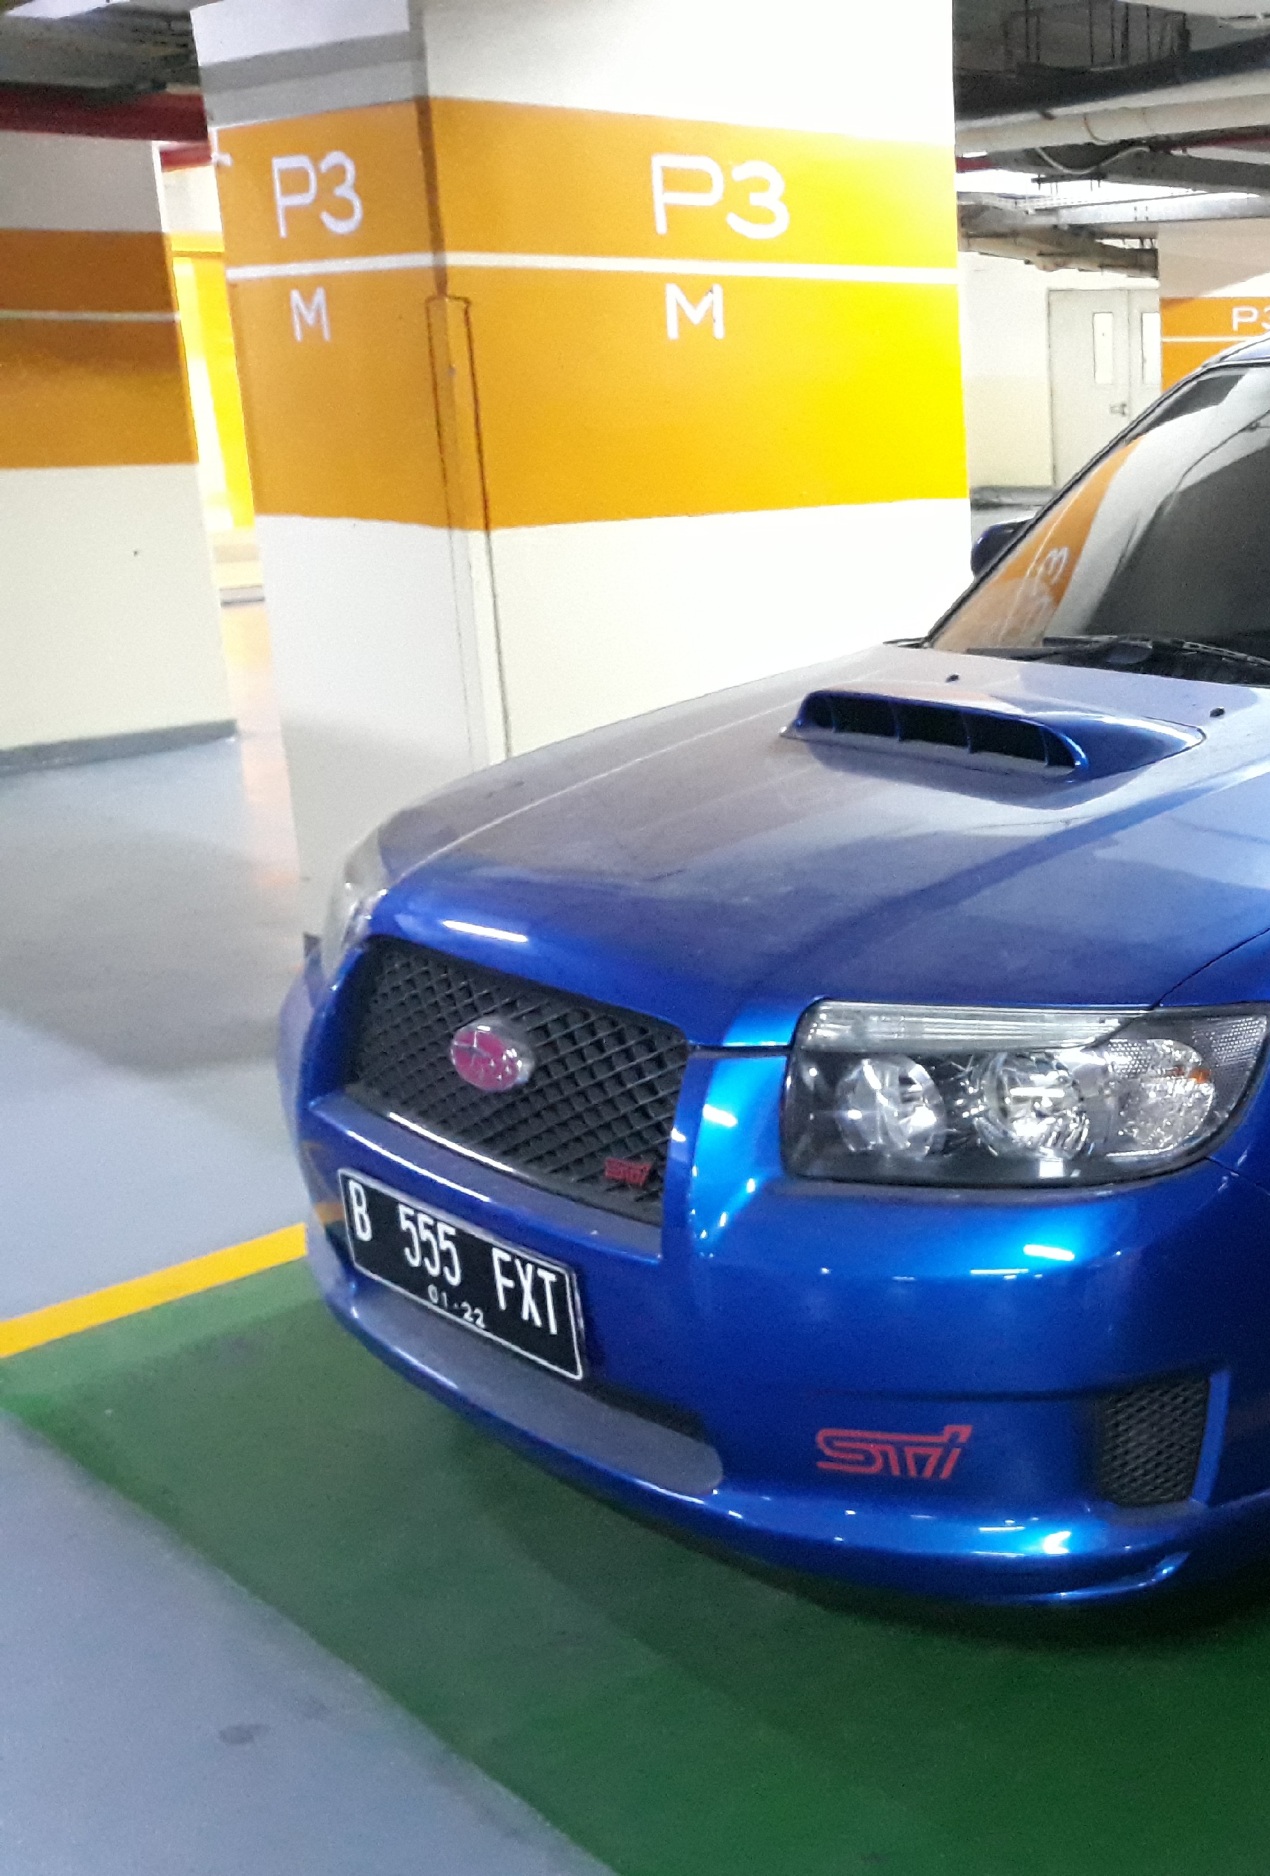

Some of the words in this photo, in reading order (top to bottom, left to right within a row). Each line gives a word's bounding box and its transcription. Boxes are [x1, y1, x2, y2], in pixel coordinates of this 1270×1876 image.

[271, 151, 363, 238] P3
[651, 153, 790, 239] P3
[290, 286, 331, 341] M
[665, 283, 726, 340] M
[348, 1180, 373, 1241] B
[399, 1205, 462, 1286] 555
[491, 1246, 558, 1335] FXT
